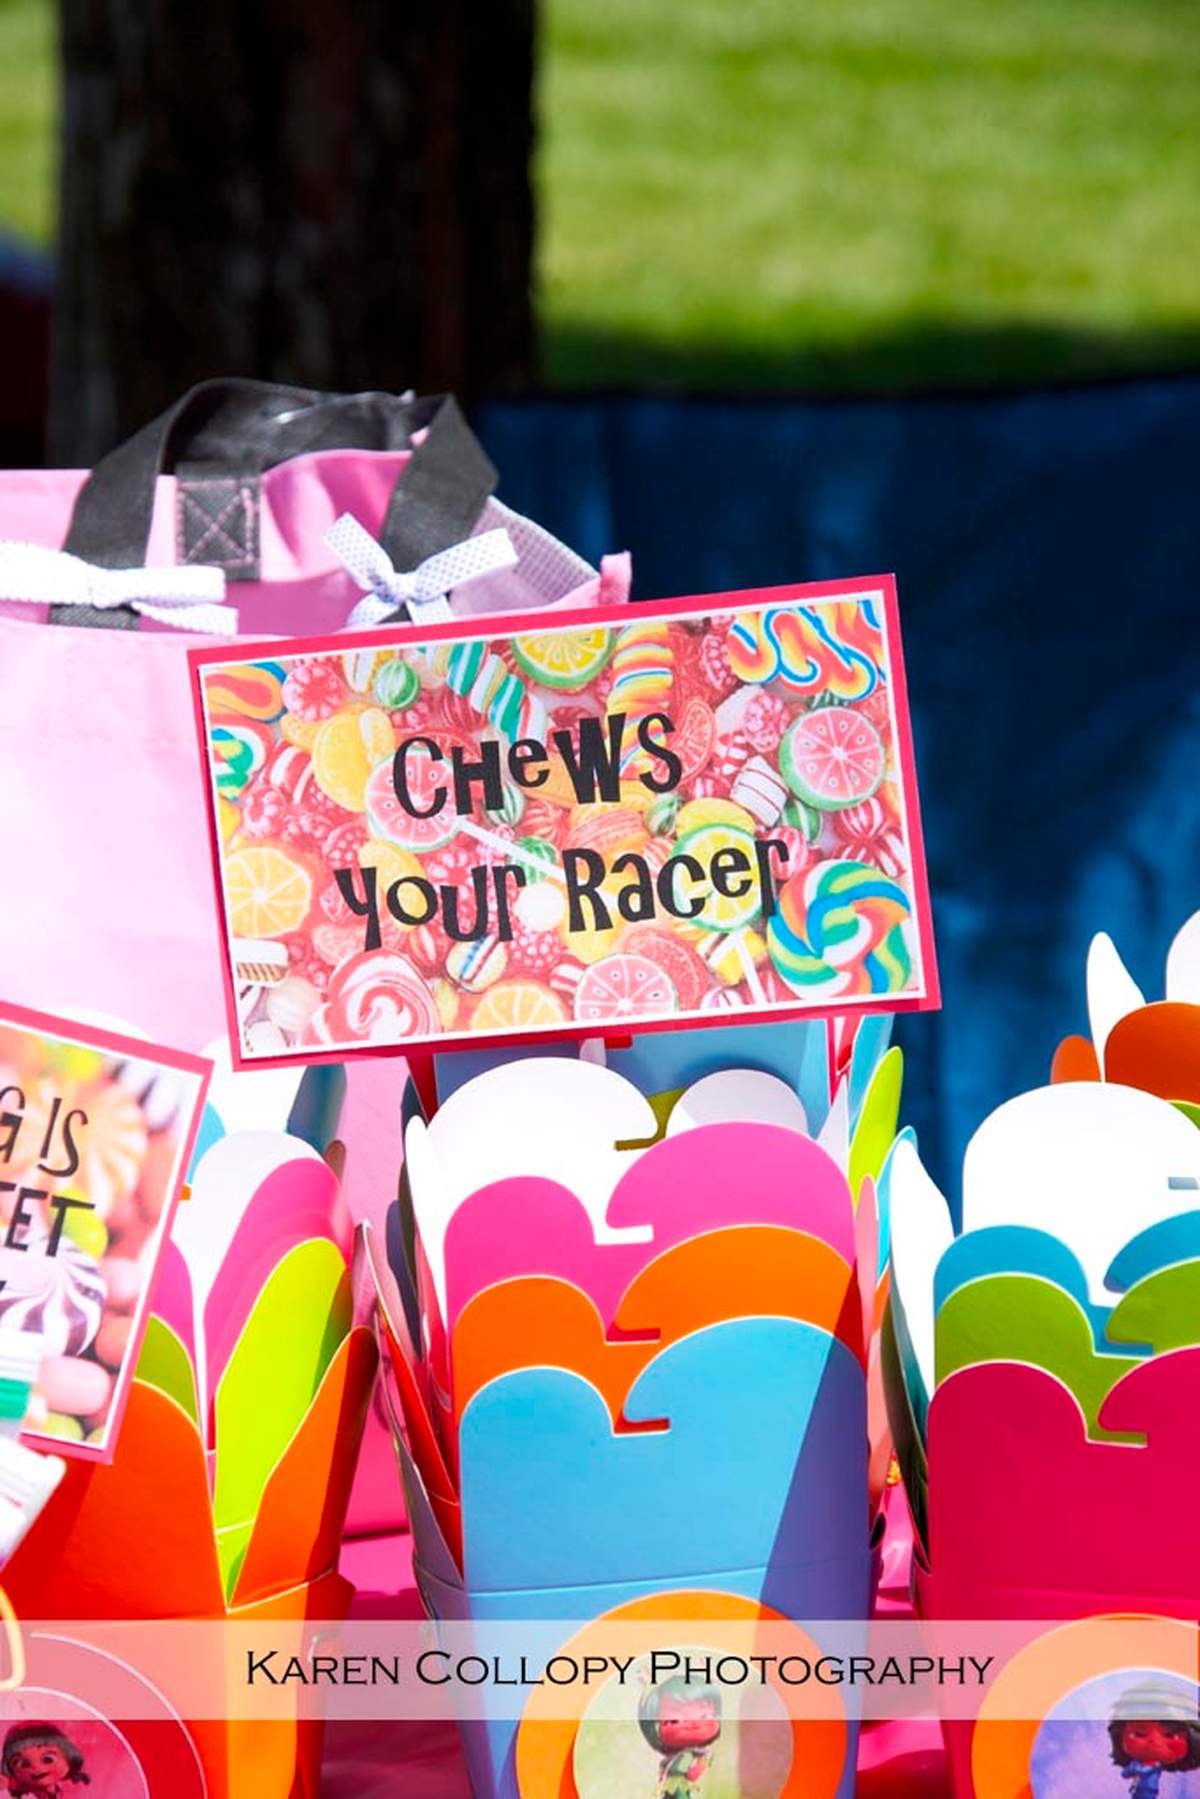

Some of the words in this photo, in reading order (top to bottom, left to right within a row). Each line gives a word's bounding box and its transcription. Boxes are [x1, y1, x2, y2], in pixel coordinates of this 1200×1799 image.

[562, 838, 789, 932] Racer
[37, 1097, 88, 1178] IS
[0, 1181, 95, 1258] ET
